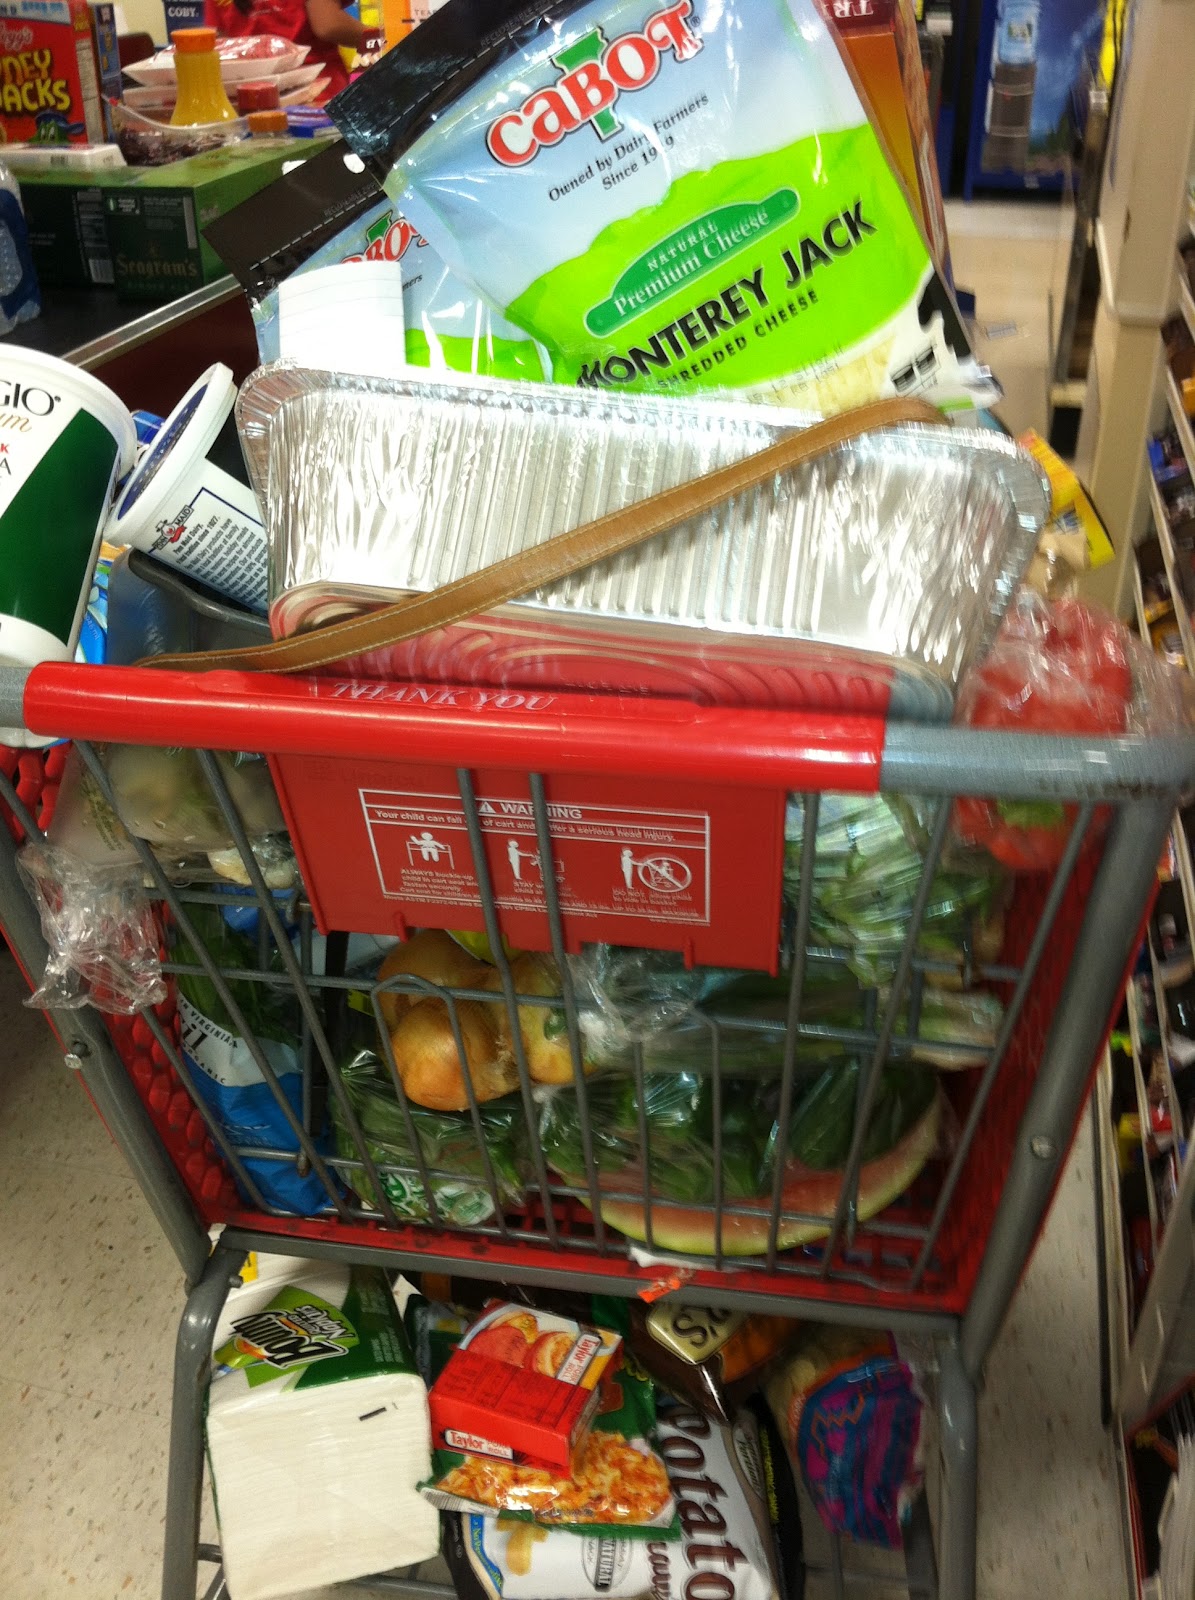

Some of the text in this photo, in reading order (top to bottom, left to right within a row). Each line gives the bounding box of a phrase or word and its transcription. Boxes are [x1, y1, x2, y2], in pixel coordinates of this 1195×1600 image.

[548, 165, 594, 201] Owned
[595, 153, 613, 172] by
[653, 95, 709, 134] Farmers
[602, 135, 675, 190] Since 199
[117, 253, 198, 278] Seagram's
[613, 208, 771, 316] Premium Cheese
[647, 220, 720, 272] NATURAL
[577, 266, 770, 388] MONTEREY
[780, 199, 878, 290] JACK
[657, 335, 748, 388] SHREDDED
[754, 287, 819, 338] CHEESE
[174, 507, 192, 527] MAID
[332, 682, 558, 711] THANK YOU
[375, 809, 398, 819] Your
[401, 812, 425, 822] child
[427, 815, 445, 823] can
[447, 815, 462, 824] fall
[495, 820, 514, 828] cart
[570, 1334, 599, 1366] Taylor
[449, 1431, 484, 1450] Taylor
